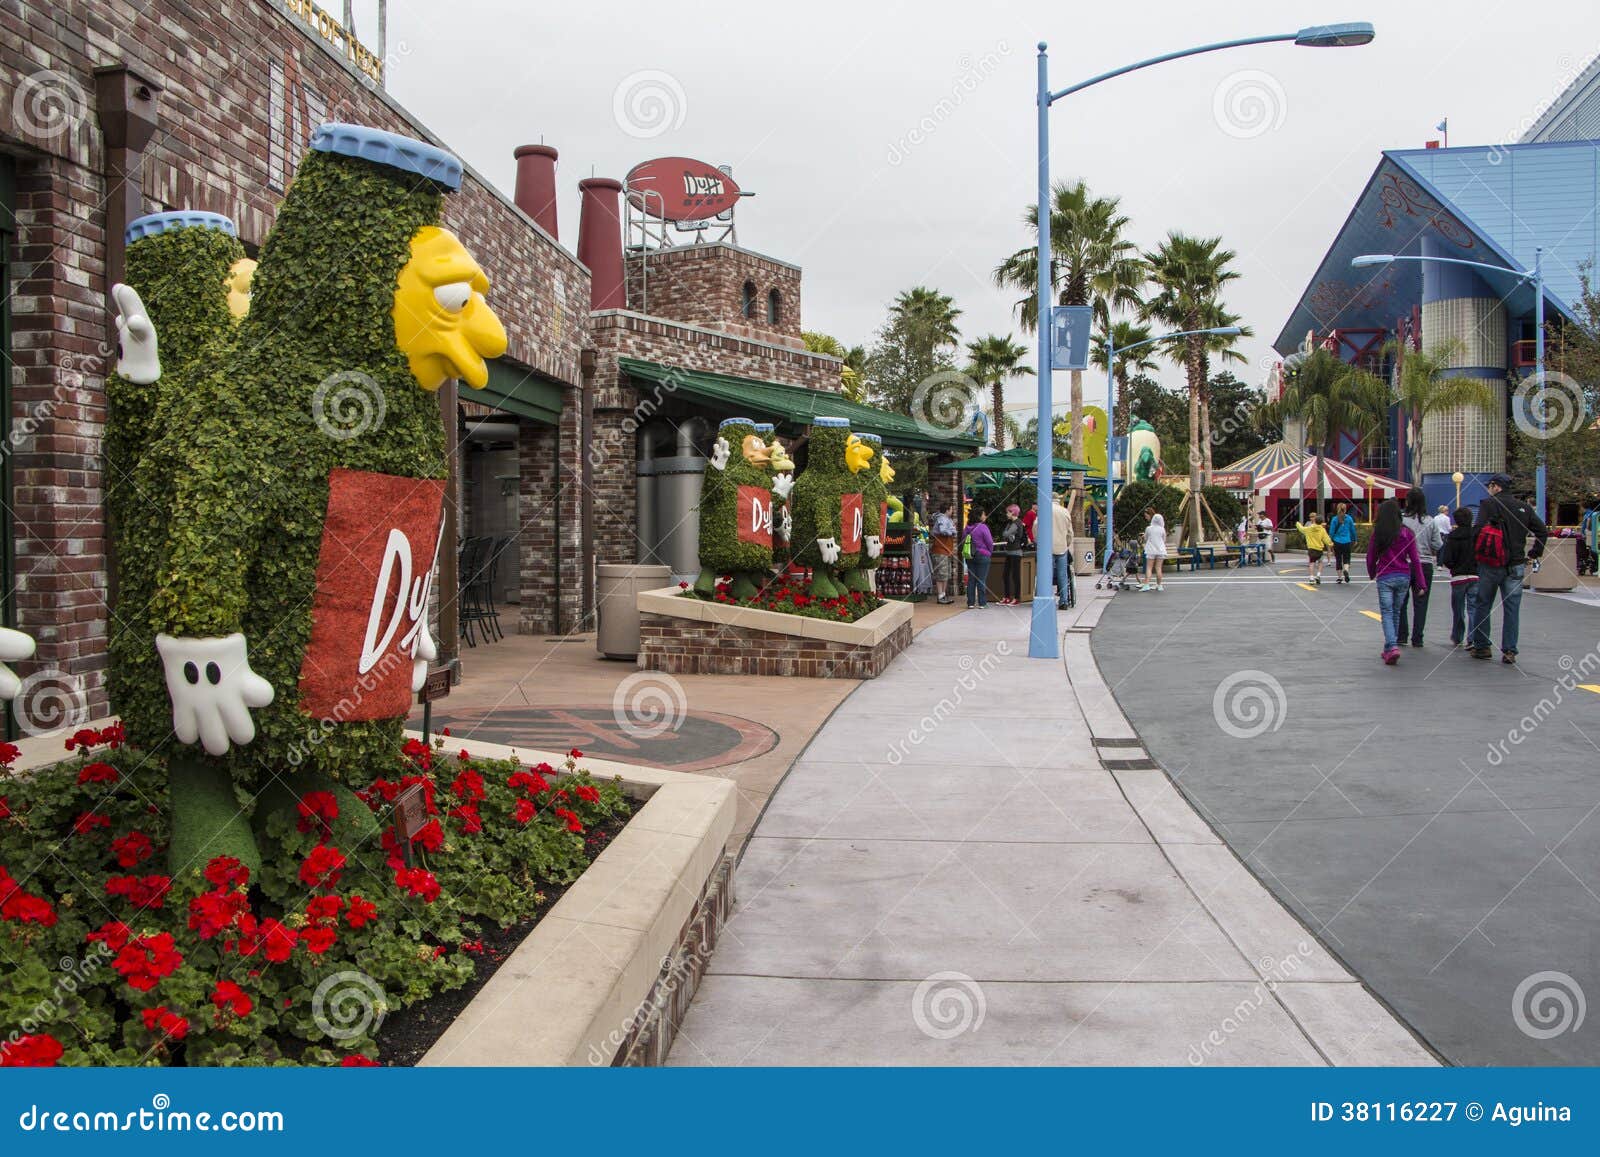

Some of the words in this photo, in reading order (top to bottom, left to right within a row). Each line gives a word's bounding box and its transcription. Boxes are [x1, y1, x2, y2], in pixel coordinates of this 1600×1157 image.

[318, 9, 343, 46] OF
[345, 31, 382, 86] THAT
[684, 170, 721, 197] Duff
